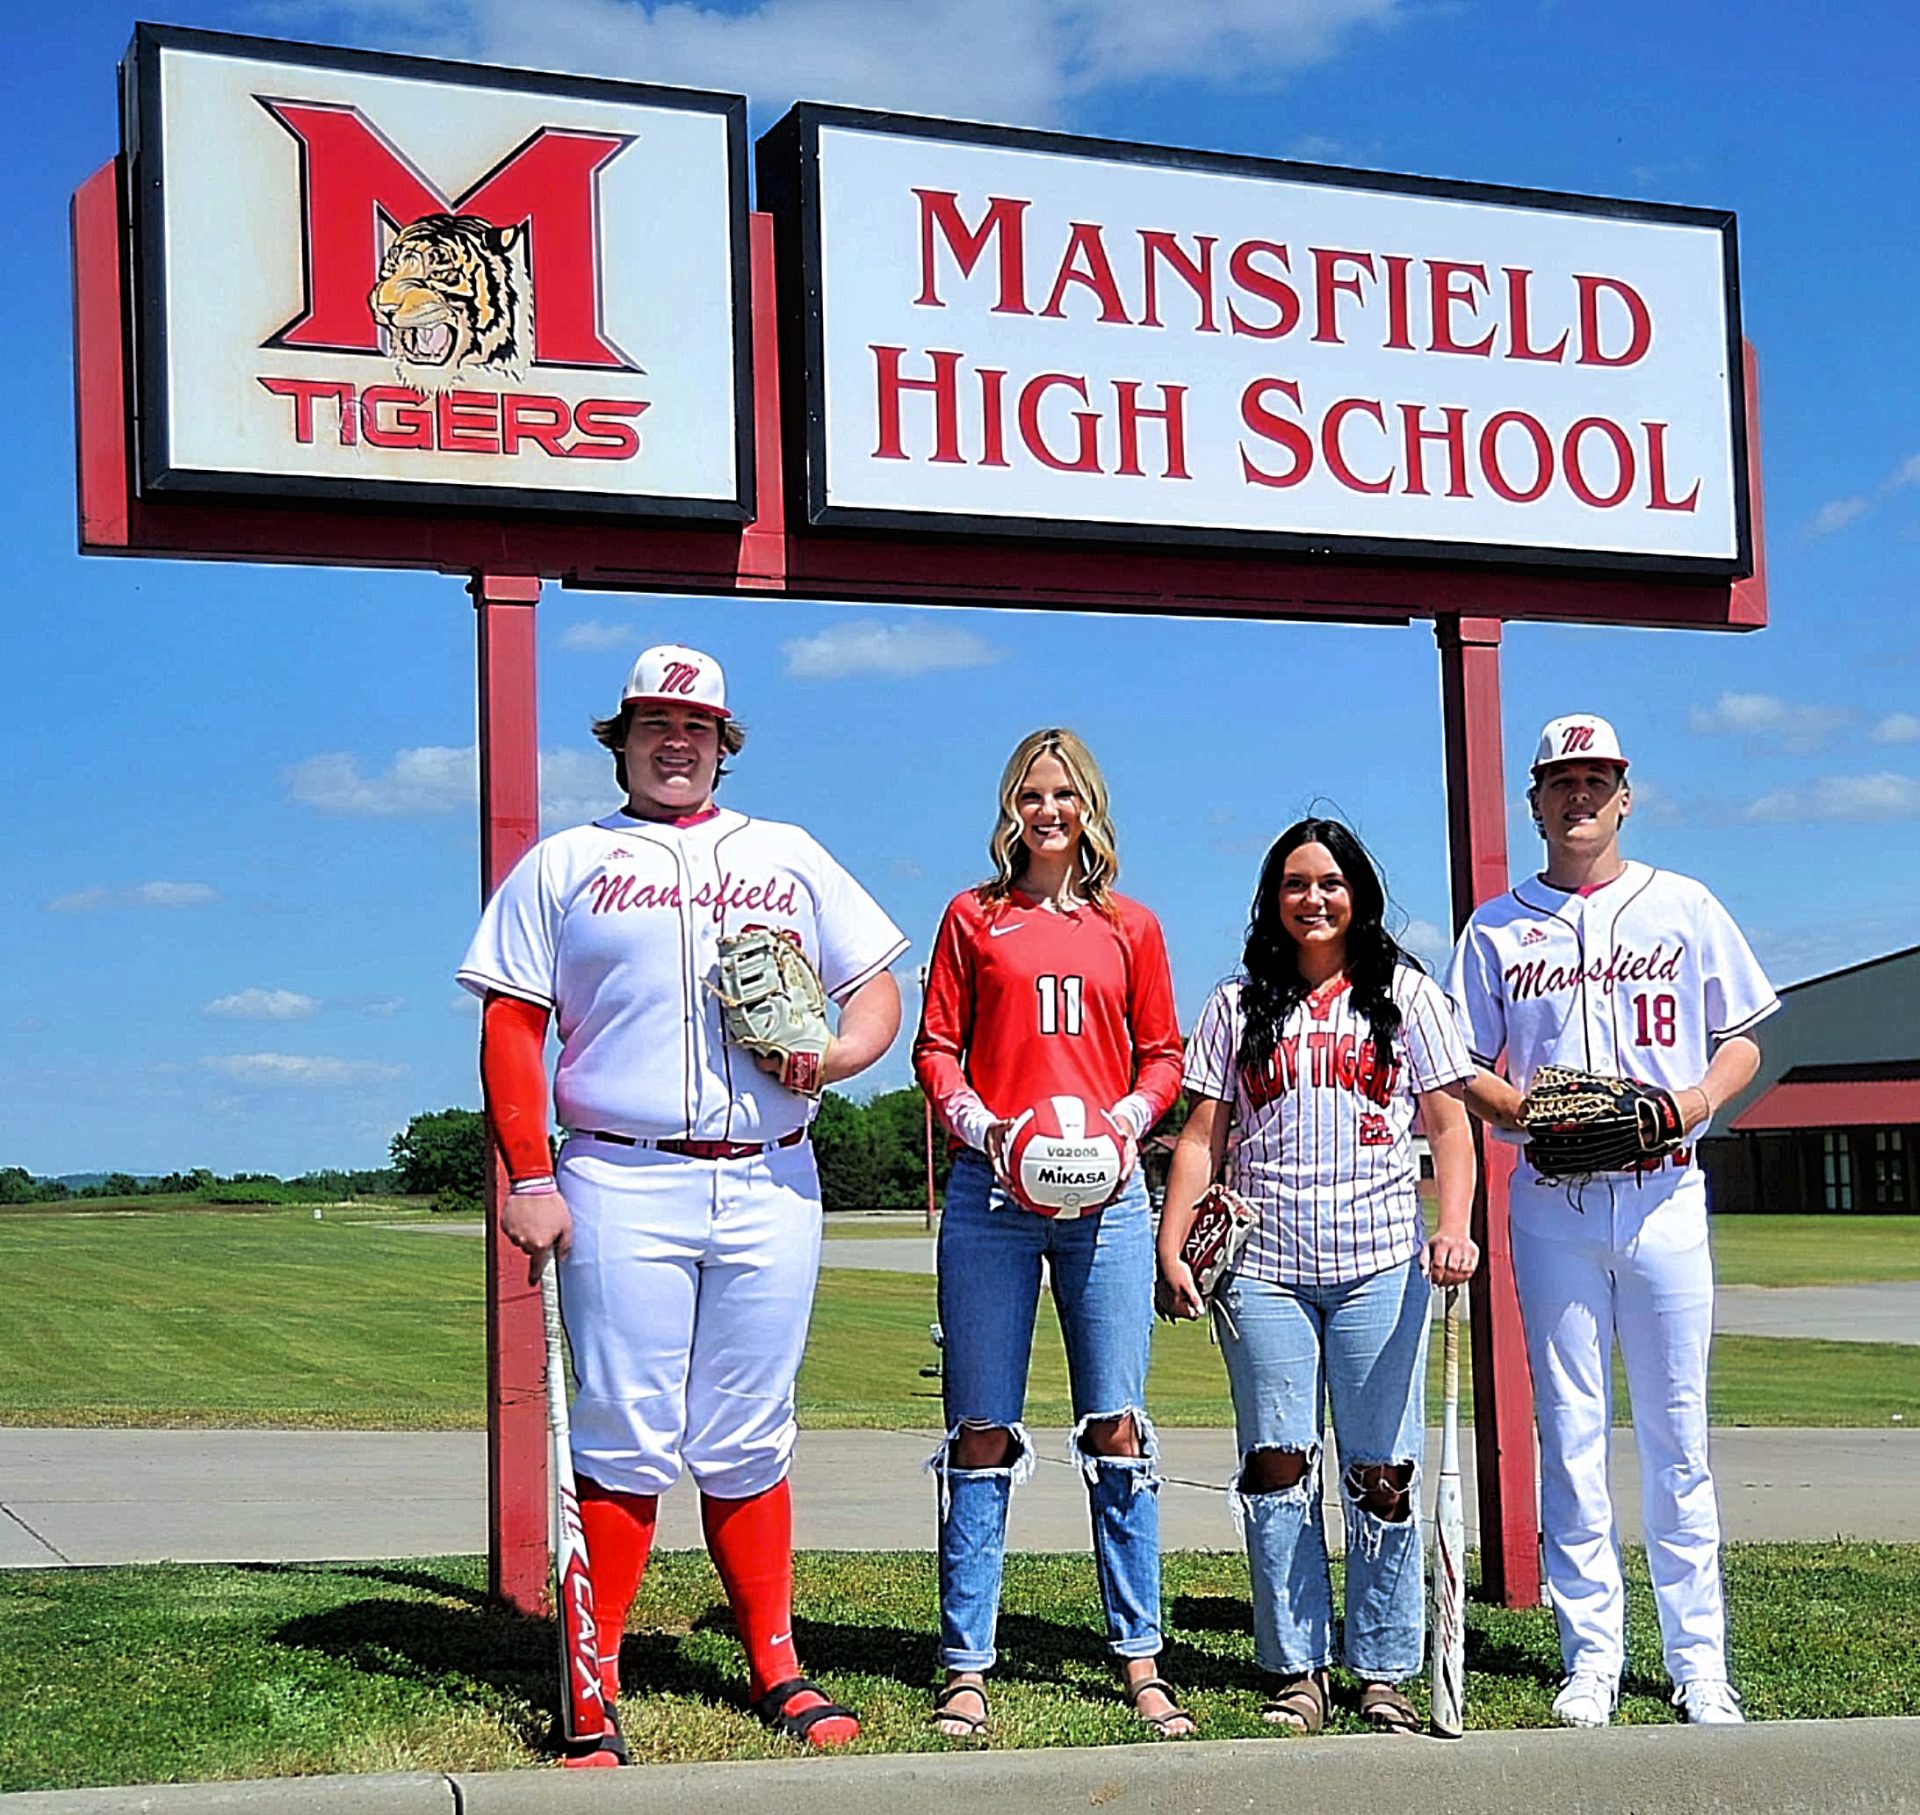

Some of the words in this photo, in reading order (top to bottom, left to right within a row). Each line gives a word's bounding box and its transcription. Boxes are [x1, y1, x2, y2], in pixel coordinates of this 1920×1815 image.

[251, 93, 646, 375] M
[910, 188, 1652, 368] MANSFIELD
[257, 376, 651, 461] TIGERS
[868, 344, 1193, 480] HIGH
[1239, 376, 1702, 514] SCHOOL
[658, 661, 700, 695] M
[1561, 725, 1595, 755] M
[590, 872, 798, 924] Mansfield
[1504, 944, 1684, 1003] Mansfield
[1037, 975, 1082, 1036] 11
[1633, 993, 1676, 1047] 18
[1242, 1034, 1301, 1113] DY
